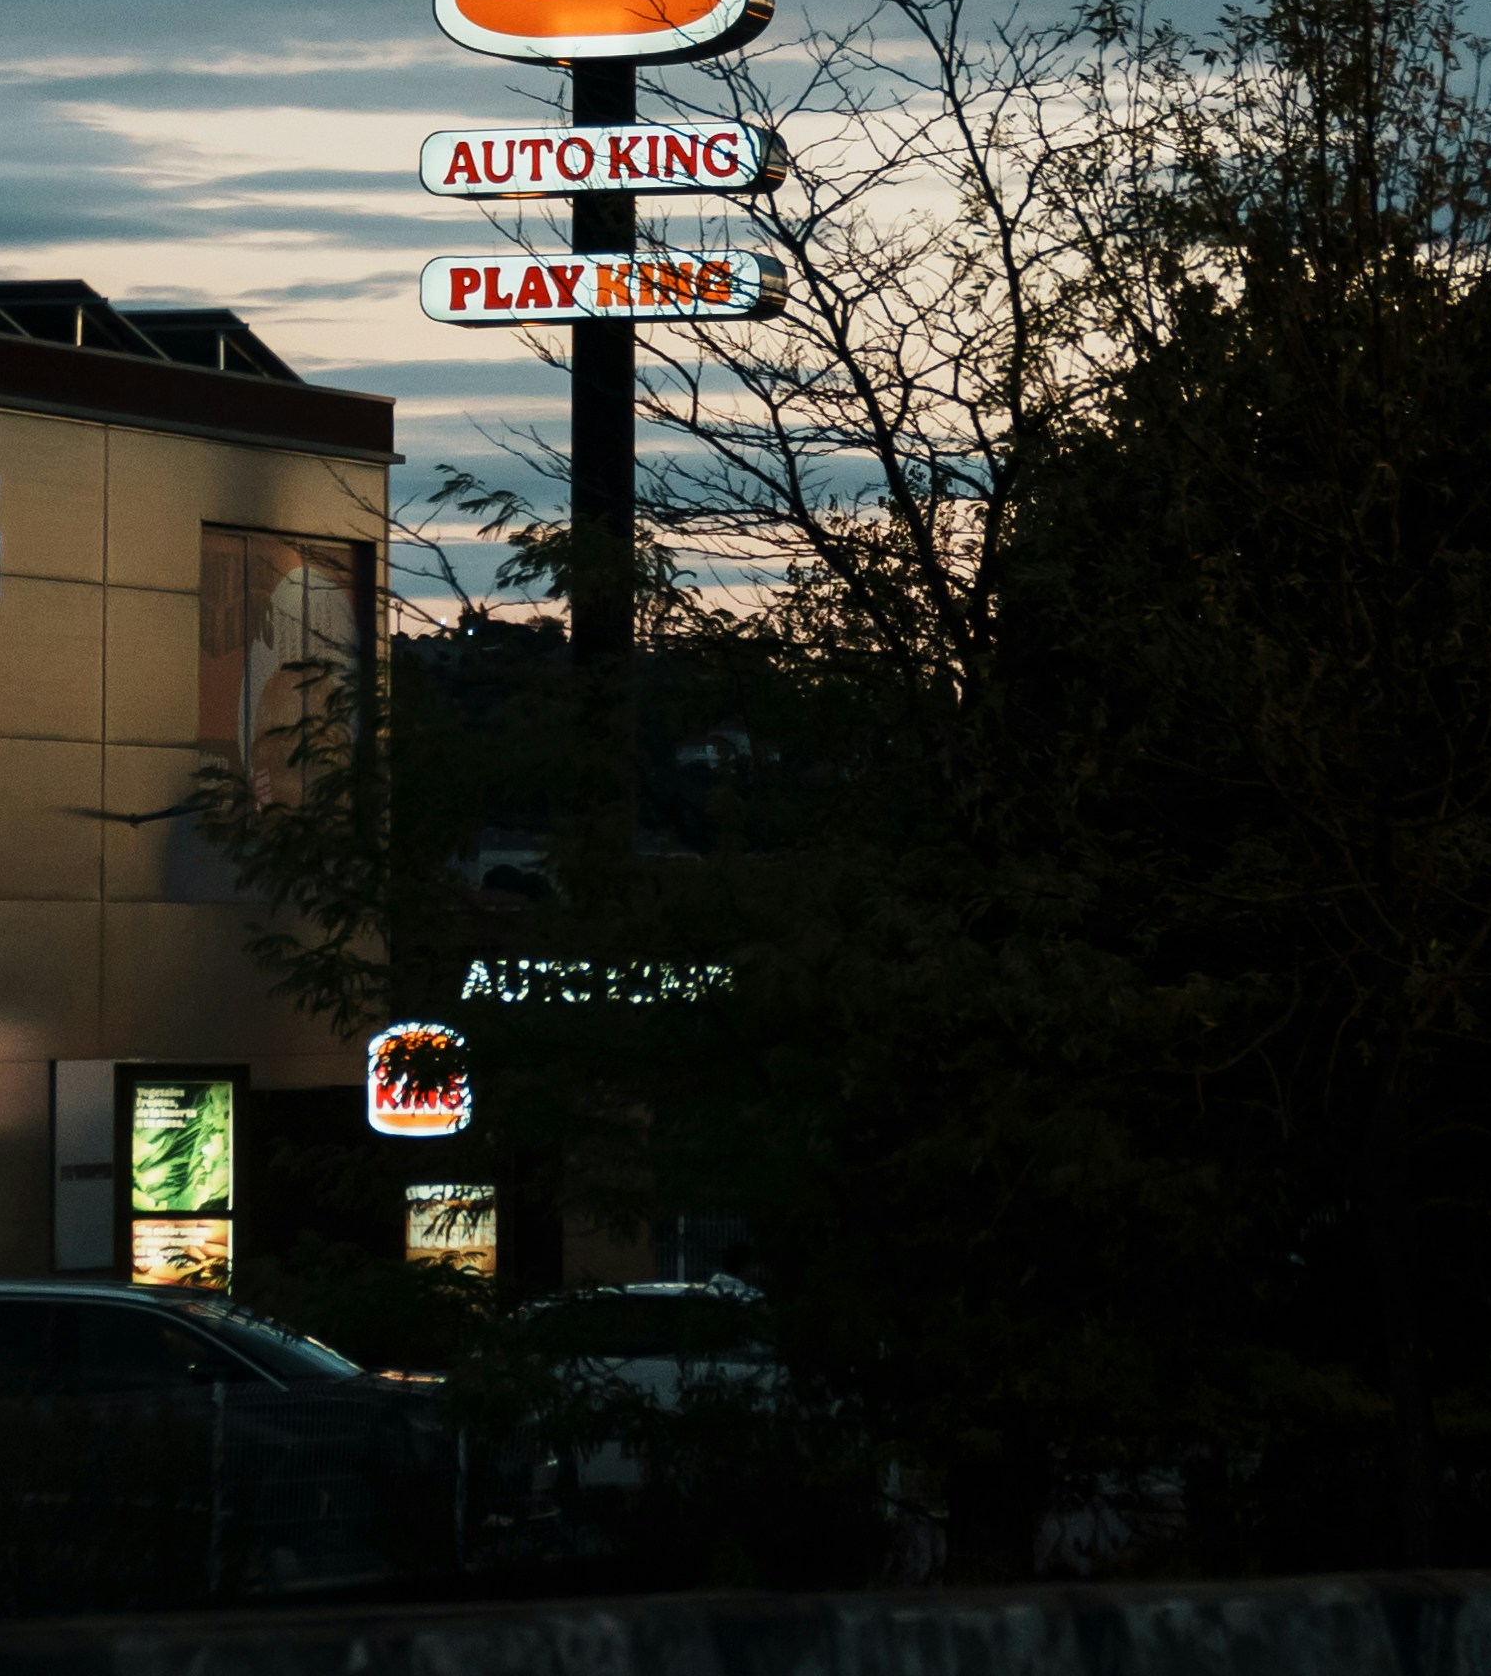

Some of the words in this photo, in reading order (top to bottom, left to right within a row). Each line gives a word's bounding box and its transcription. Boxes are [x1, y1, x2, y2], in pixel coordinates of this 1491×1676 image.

[443, 137, 594, 184] AUTO
[608, 132, 739, 181] KING
[449, 265, 585, 311] PLAY
[595, 260, 734, 308] KING
